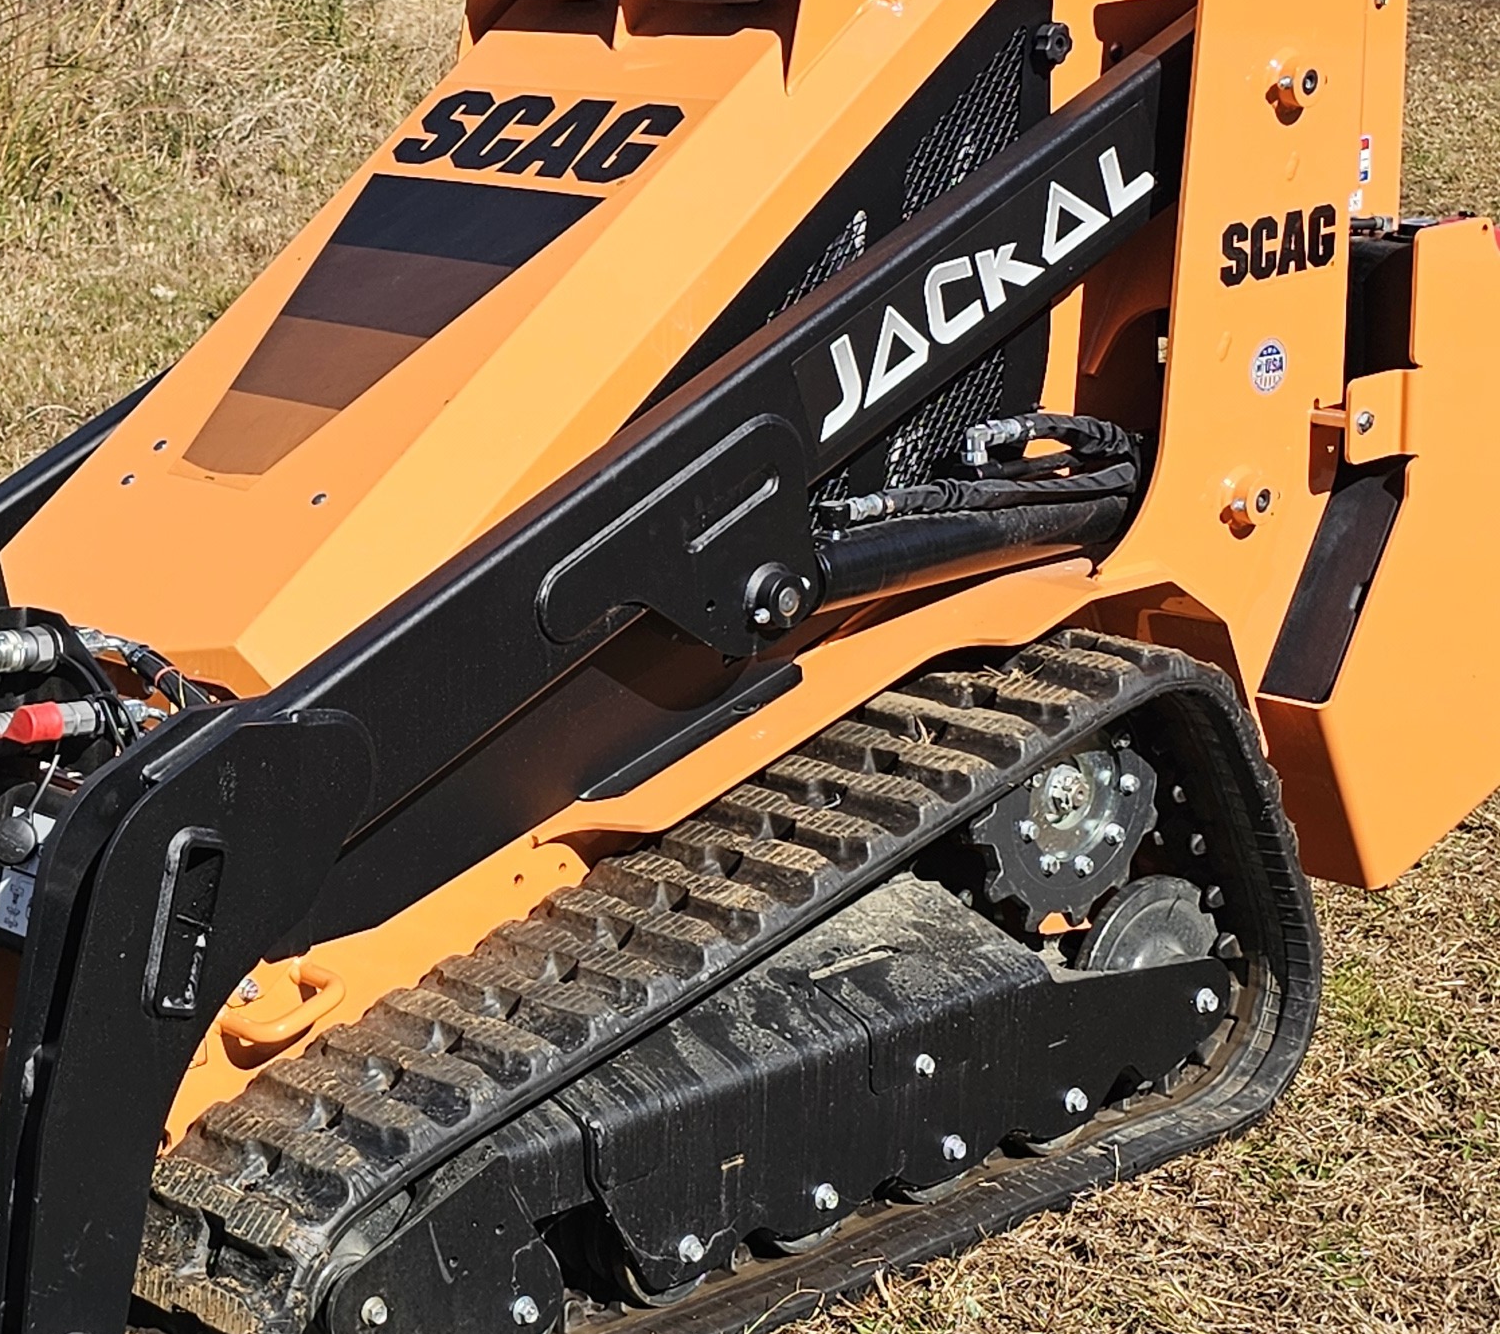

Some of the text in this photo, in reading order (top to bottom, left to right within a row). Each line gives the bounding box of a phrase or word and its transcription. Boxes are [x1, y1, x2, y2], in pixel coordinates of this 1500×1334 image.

[392, 90, 685, 184] SCAG
[1220, 203, 1336, 288] SCAG
[819, 146, 1155, 443] JACKAL
